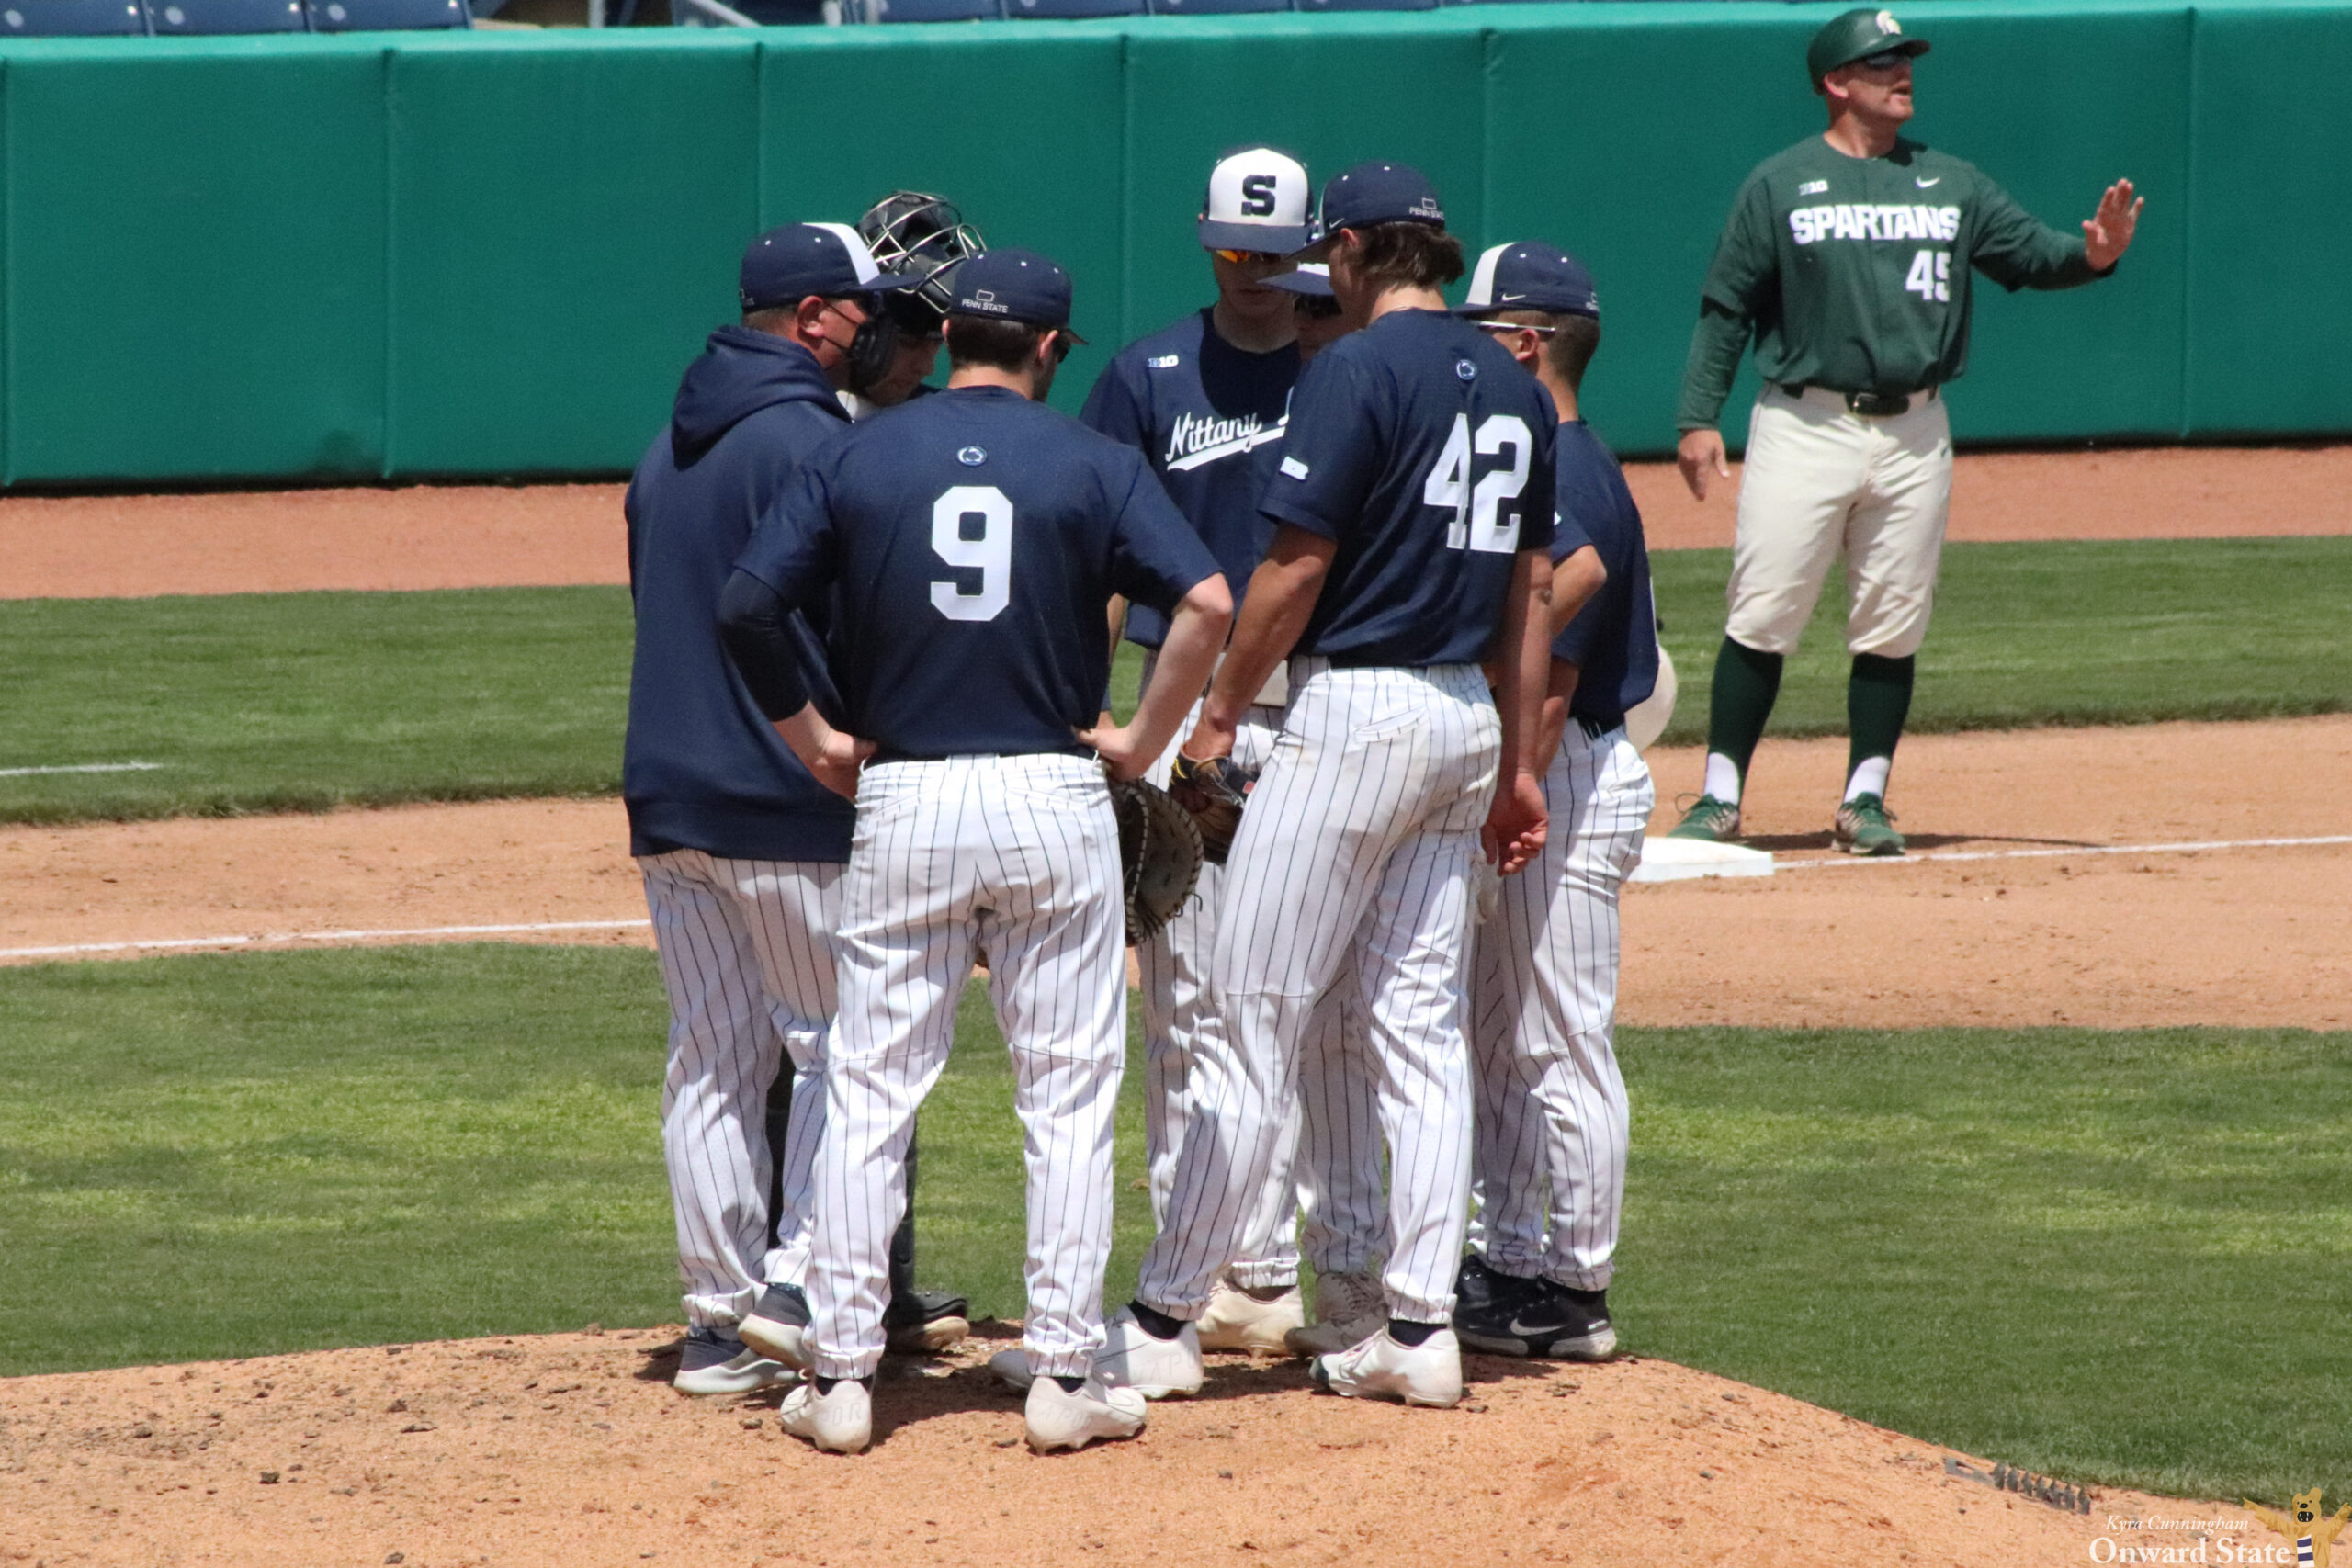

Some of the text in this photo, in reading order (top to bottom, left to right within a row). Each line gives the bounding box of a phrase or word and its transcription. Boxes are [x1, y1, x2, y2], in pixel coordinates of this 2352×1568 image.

[1241, 175, 1276, 216] S
[1789, 204, 1961, 244] SPARTANS
[1905, 250, 1951, 302] 45
[962, 299, 1008, 313] PENN STATE
[1165, 412, 1262, 462] Nittany
[1423, 412, 1532, 554] 42
[930, 486, 1013, 622] 9
